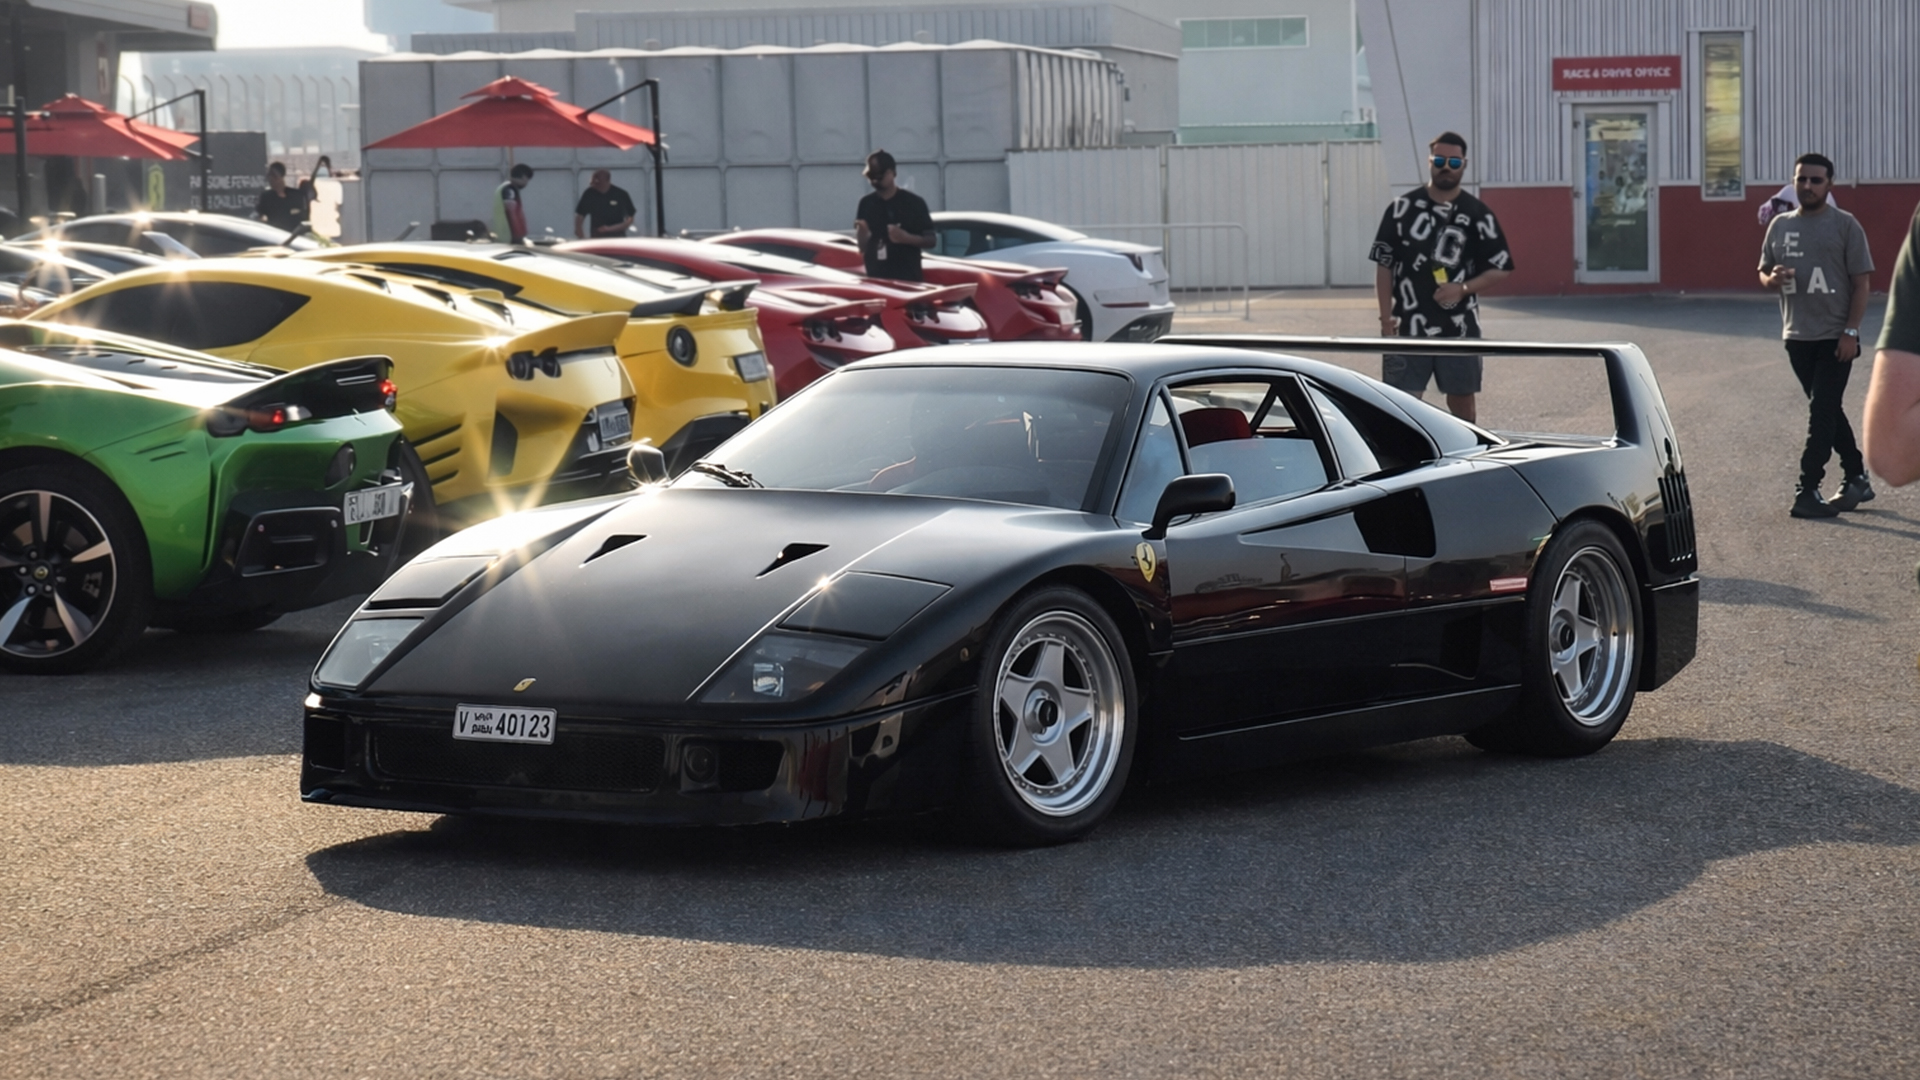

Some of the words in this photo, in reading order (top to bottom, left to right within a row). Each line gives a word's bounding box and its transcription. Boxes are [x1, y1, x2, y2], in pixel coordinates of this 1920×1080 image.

[1563, 68, 1591, 79] RACE
[1601, 67, 1633, 78] DRIVE
[1634, 66, 1672, 78] OFFICE
[460, 711, 469, 733] V
[496, 712, 551, 738] 40123
